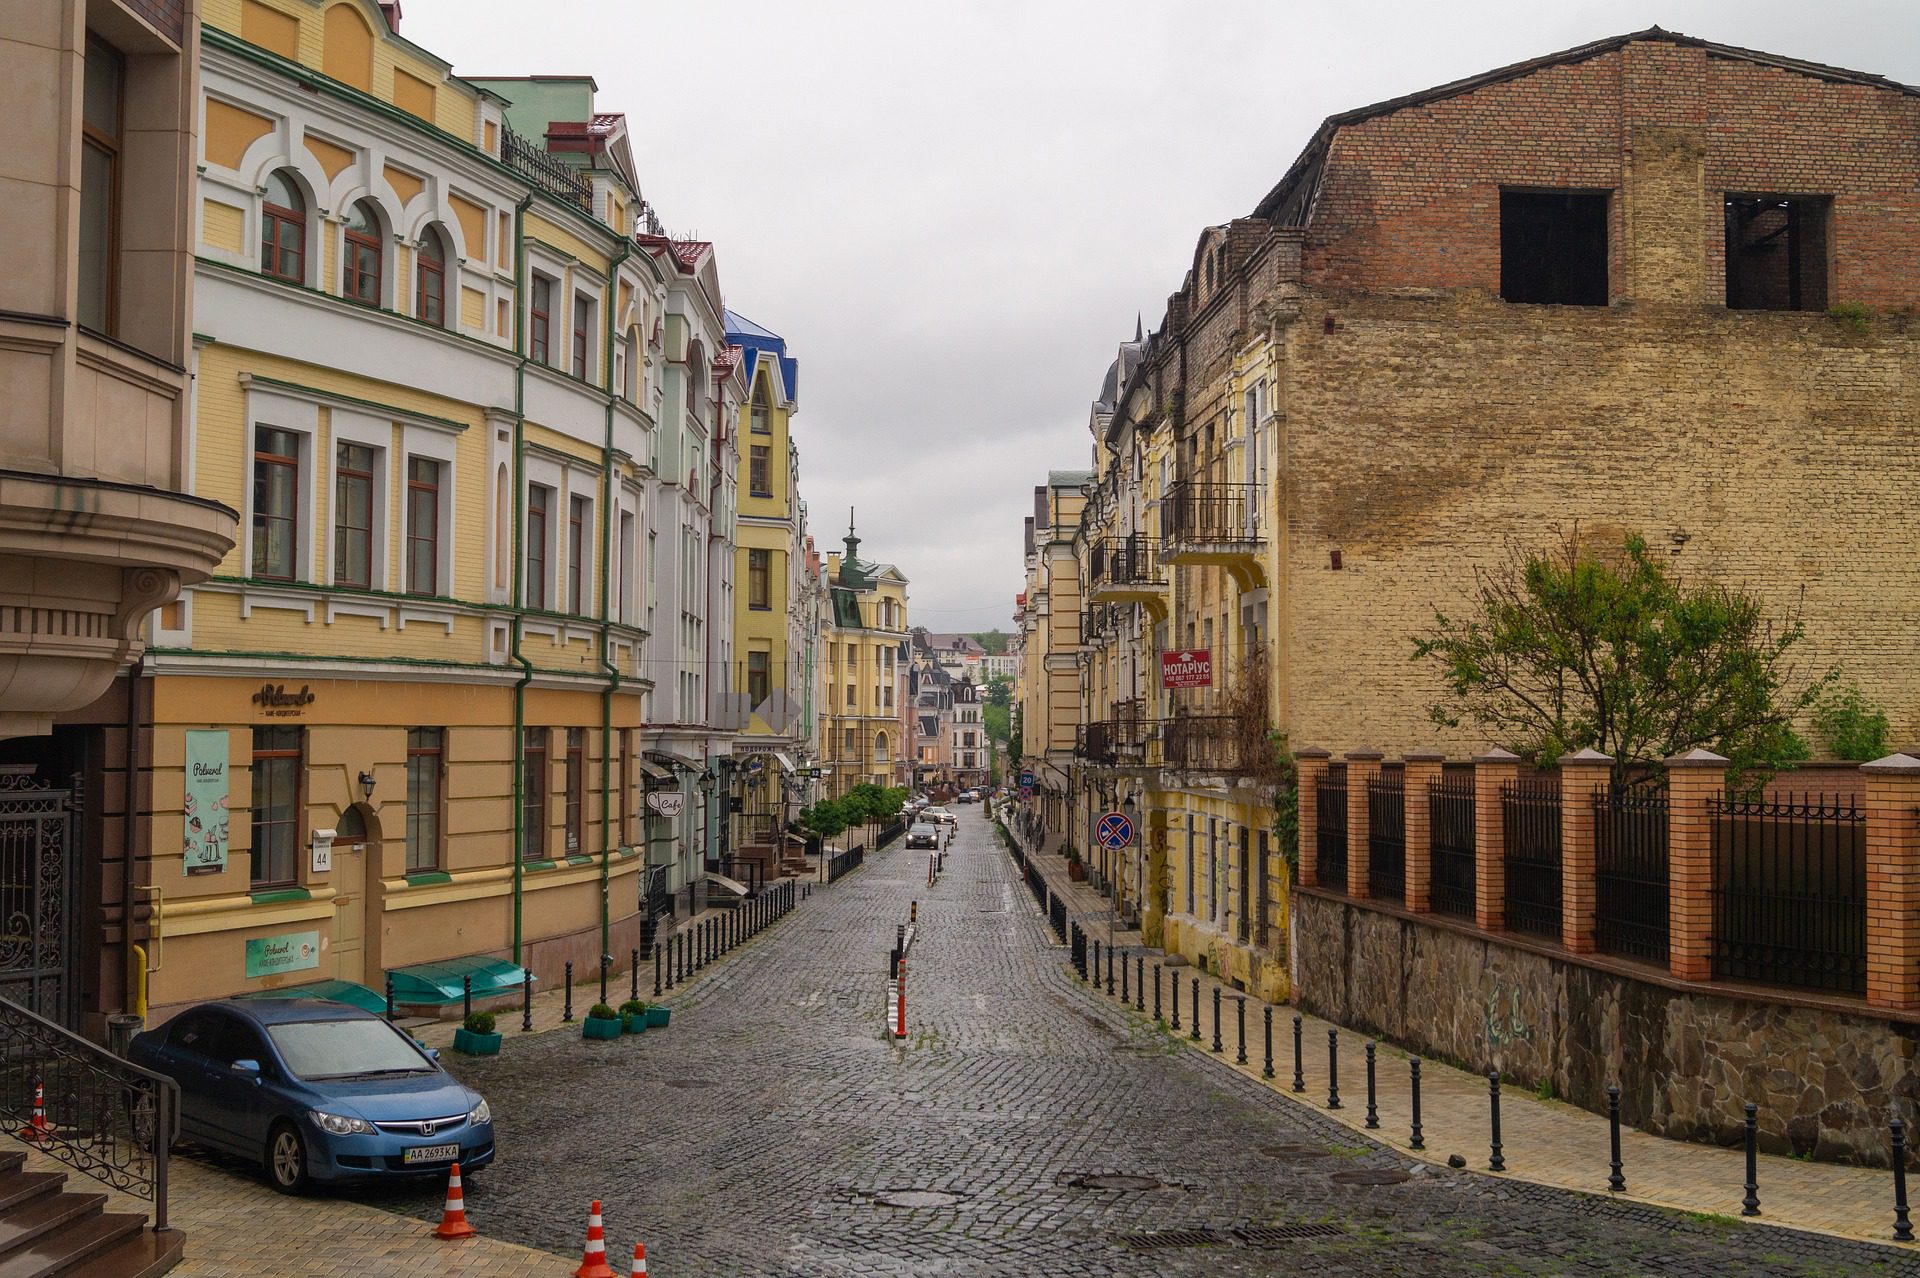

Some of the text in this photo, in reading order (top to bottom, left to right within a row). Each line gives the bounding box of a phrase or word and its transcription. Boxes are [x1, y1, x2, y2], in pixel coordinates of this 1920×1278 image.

[316, 853, 327, 865] 44
[411, 1146, 457, 1159] AA 2693 KA
